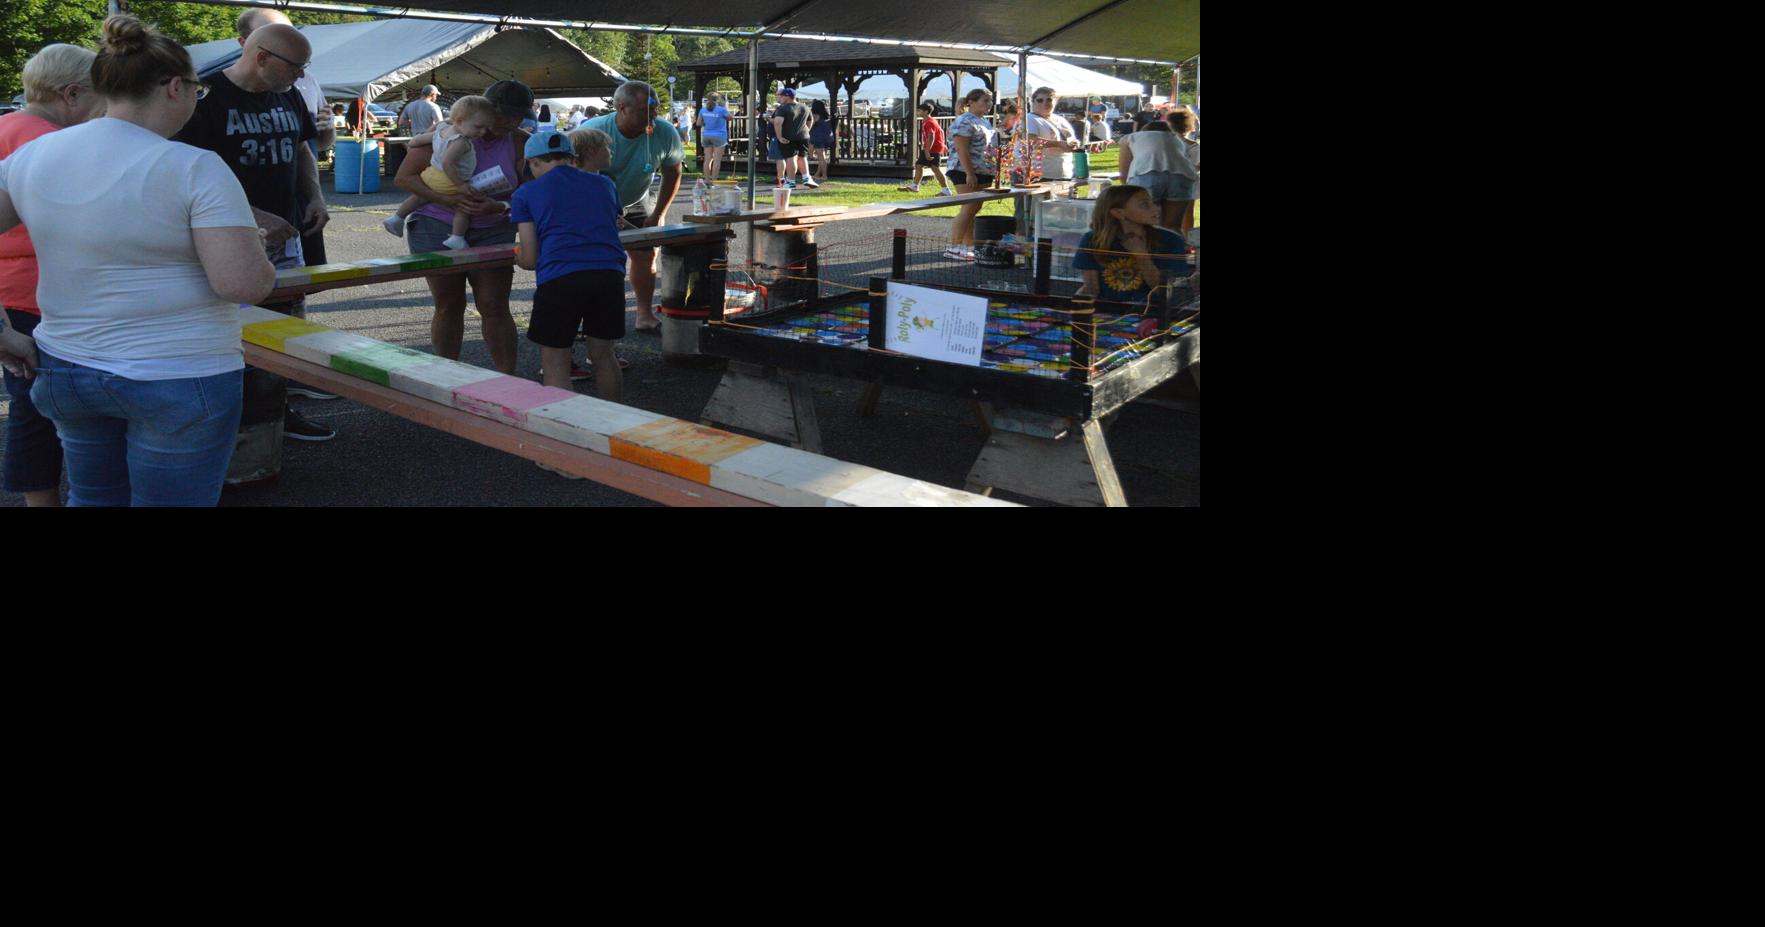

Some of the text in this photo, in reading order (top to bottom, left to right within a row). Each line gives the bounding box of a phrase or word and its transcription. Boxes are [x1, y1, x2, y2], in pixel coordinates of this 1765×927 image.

[226, 107, 300, 135] Austin
[239, 137, 294, 165] 3:16
[897, 297, 917, 343] Roly-Poly
